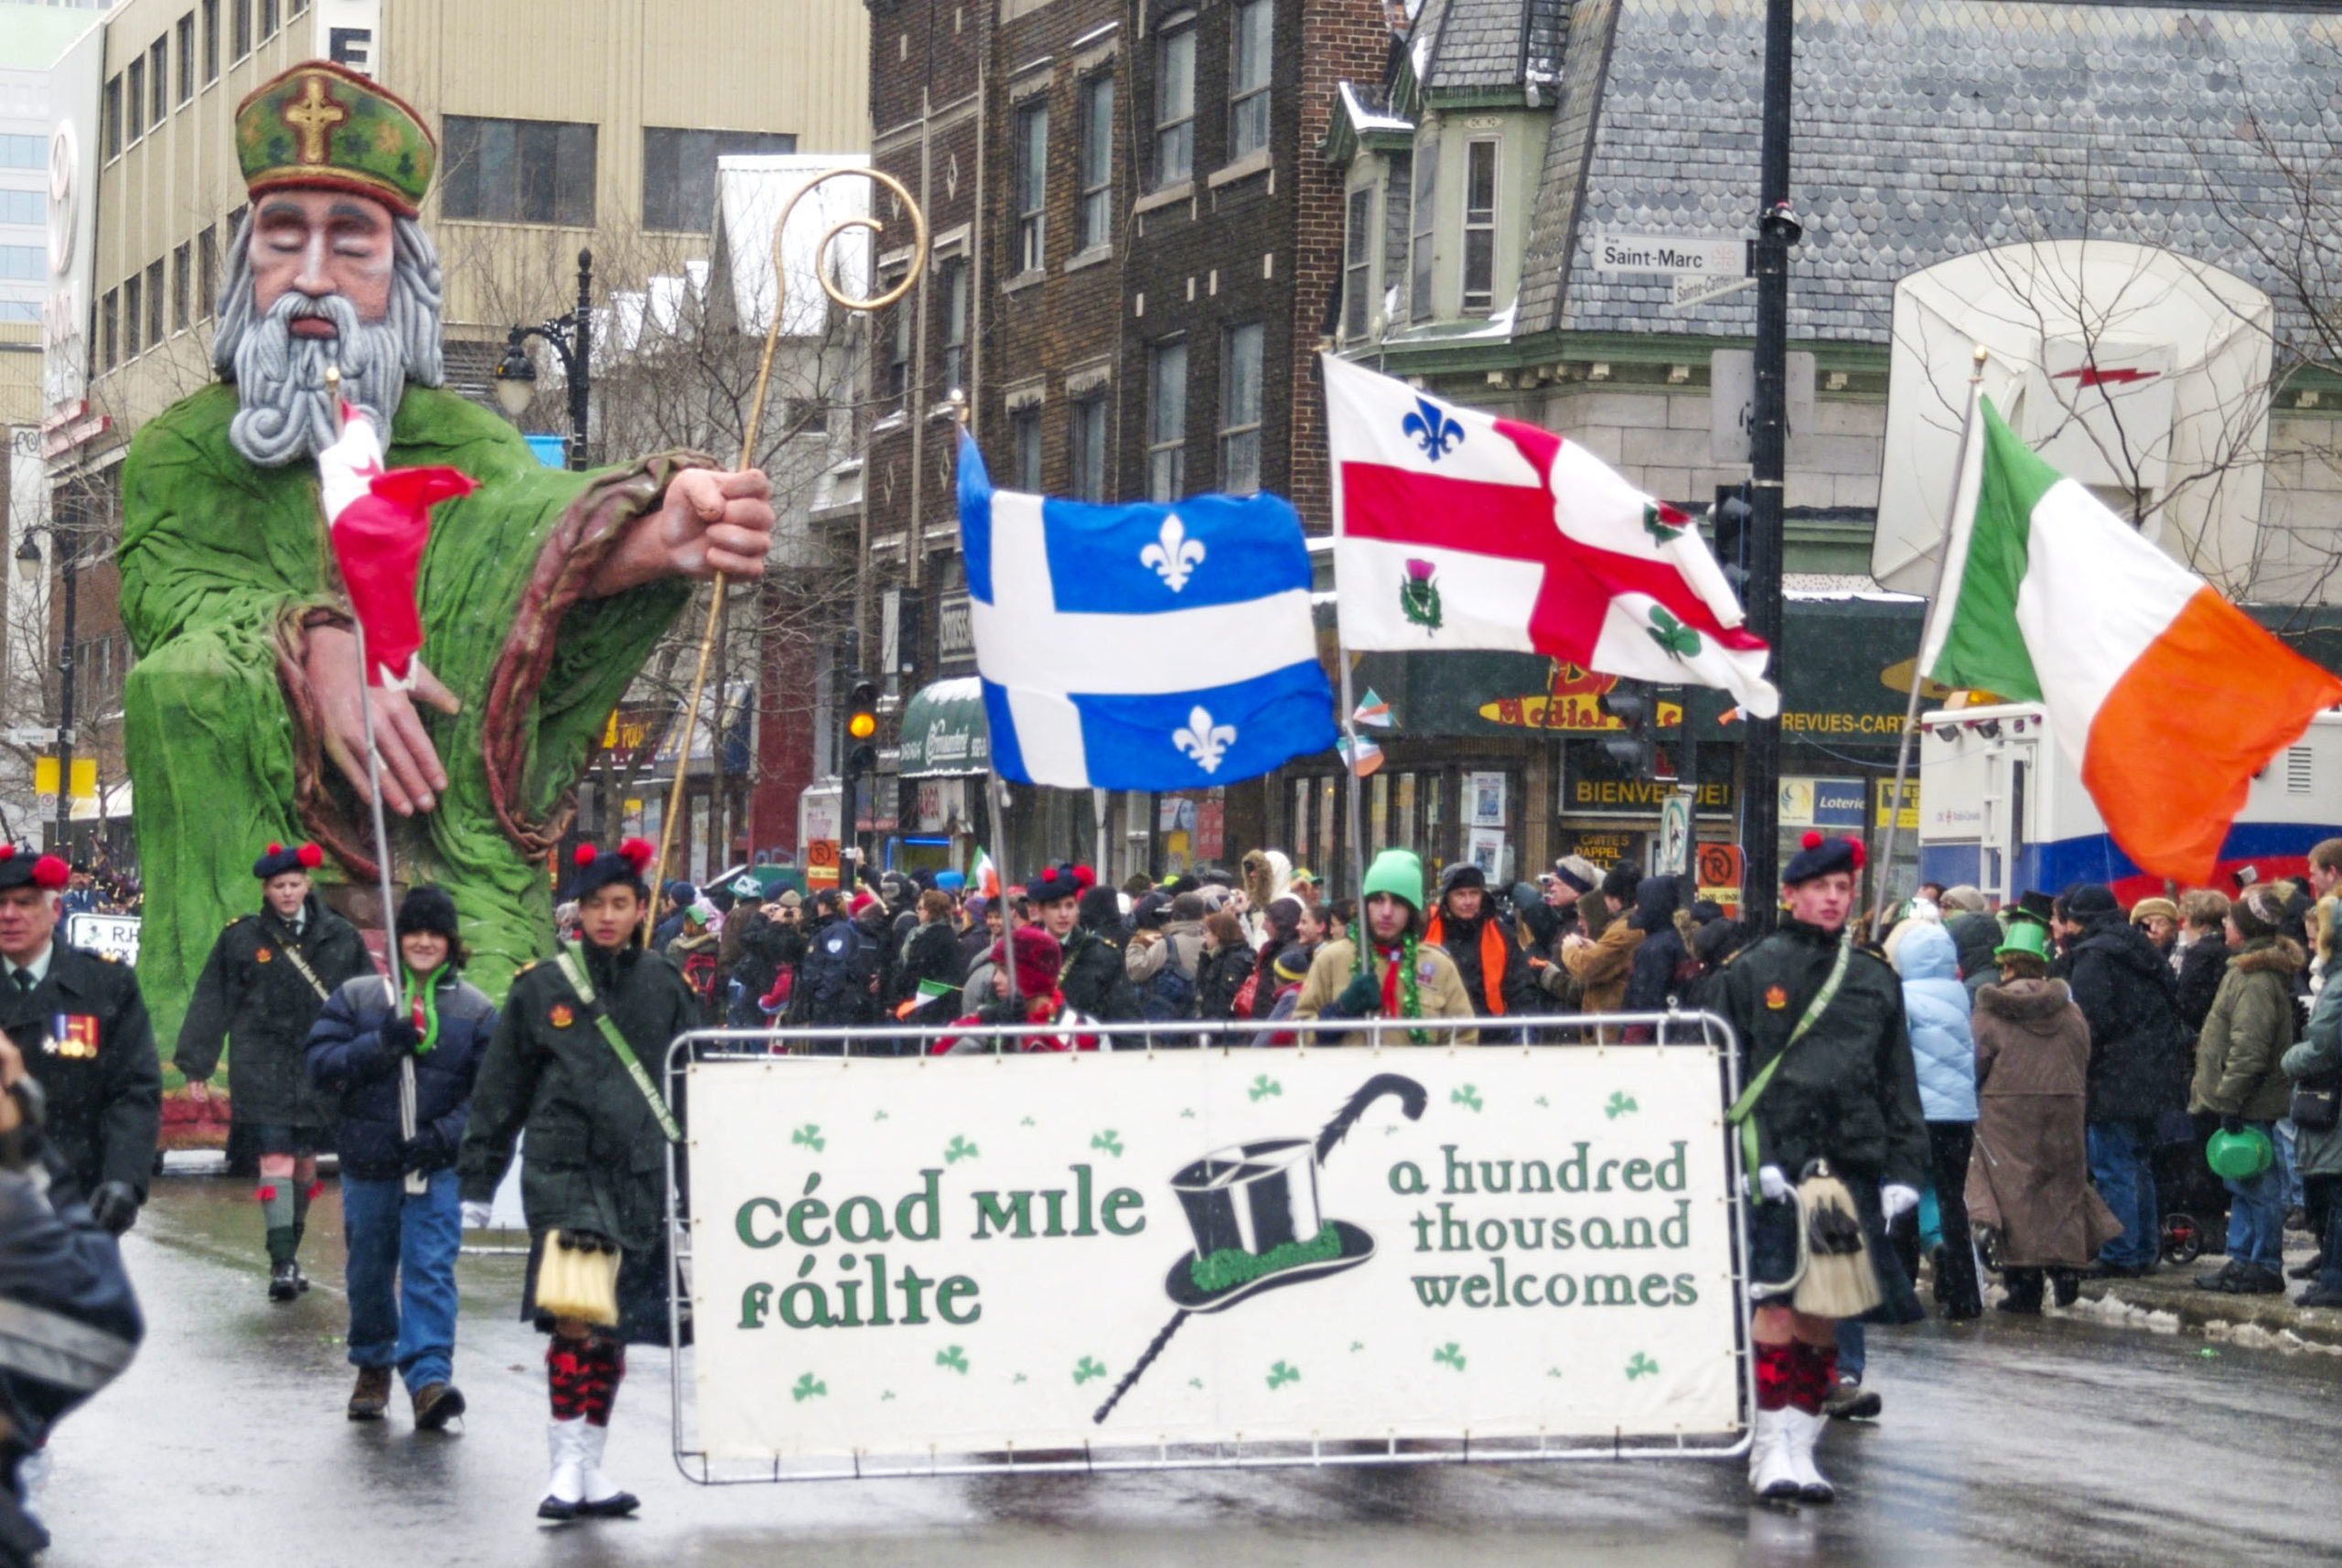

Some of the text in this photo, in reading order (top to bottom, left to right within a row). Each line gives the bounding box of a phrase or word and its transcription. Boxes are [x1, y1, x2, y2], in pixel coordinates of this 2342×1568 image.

[1604, 246, 1703, 268] Saint-Marc
[1819, 796, 1865, 810] Loterie
[1388, 1141, 1688, 1195] a hundred
[736, 1170, 943, 1249] céad
[1410, 1198, 1692, 1252] thousand
[1411, 1257, 1699, 1308] welcomes
